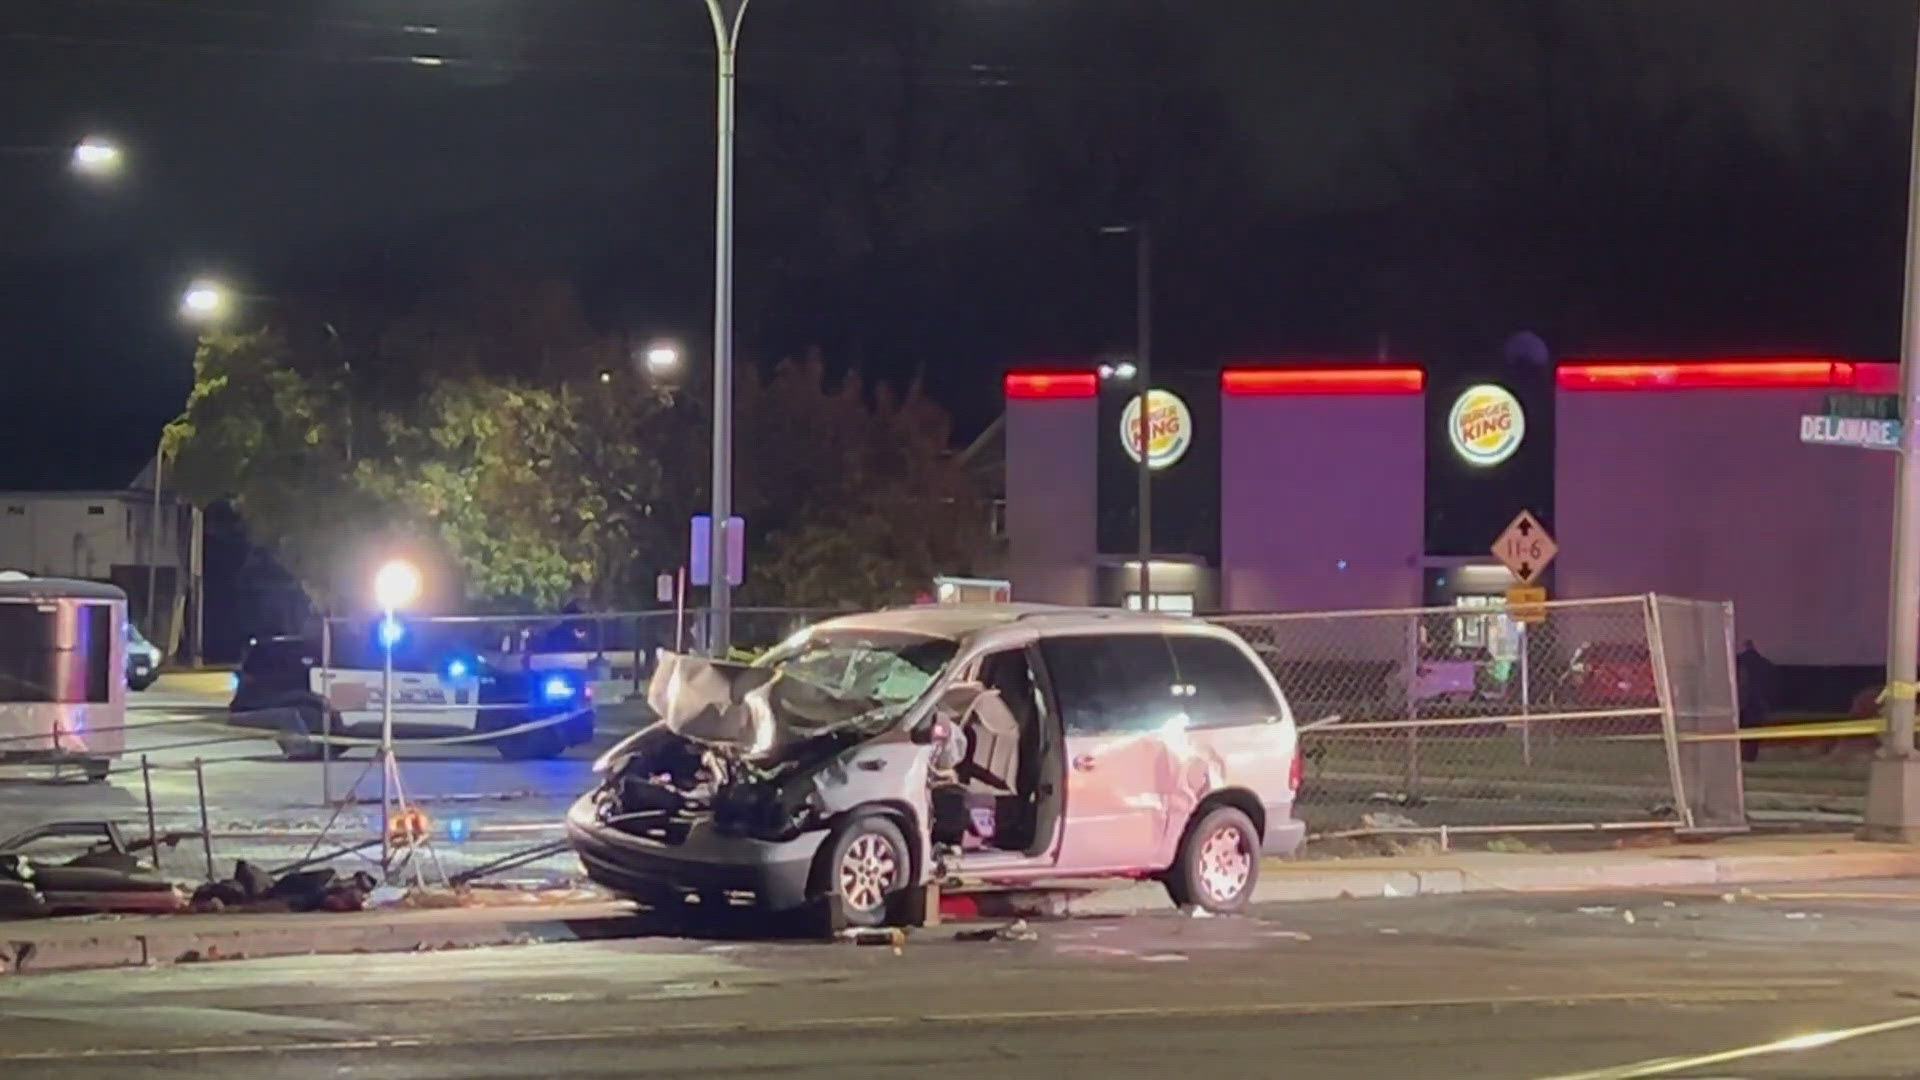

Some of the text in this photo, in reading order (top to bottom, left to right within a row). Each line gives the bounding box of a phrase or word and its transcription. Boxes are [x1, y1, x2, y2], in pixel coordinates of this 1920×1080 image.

[1460, 401, 1510, 429] BURGER
[1463, 413, 1511, 443] KING
[1801, 415, 1891, 444] DELAWARE
[1133, 417, 1180, 446] KNG
